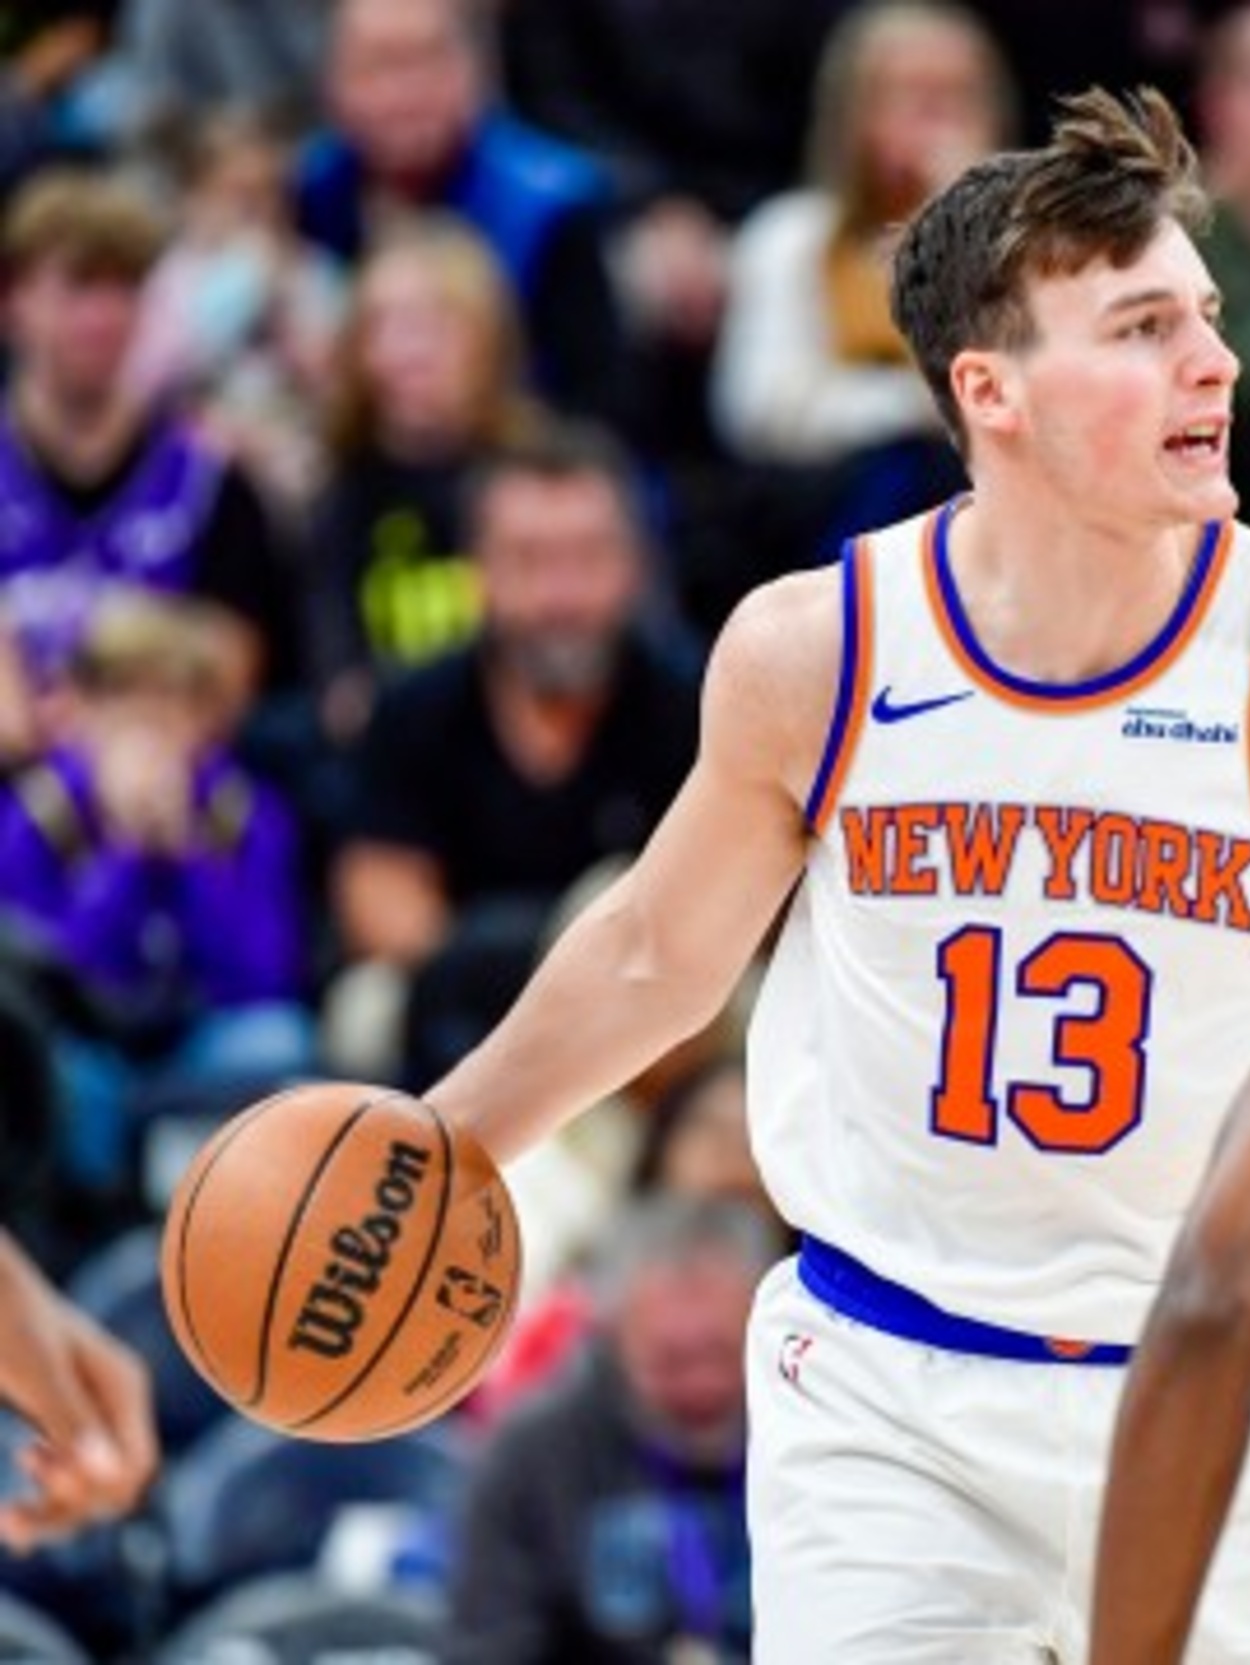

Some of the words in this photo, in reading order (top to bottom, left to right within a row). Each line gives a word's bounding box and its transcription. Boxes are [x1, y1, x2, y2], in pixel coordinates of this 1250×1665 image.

[840, 803, 1027, 896] NEW
[930, 922, 1154, 1155] 13
[287, 1140, 432, 1360] Wilson
